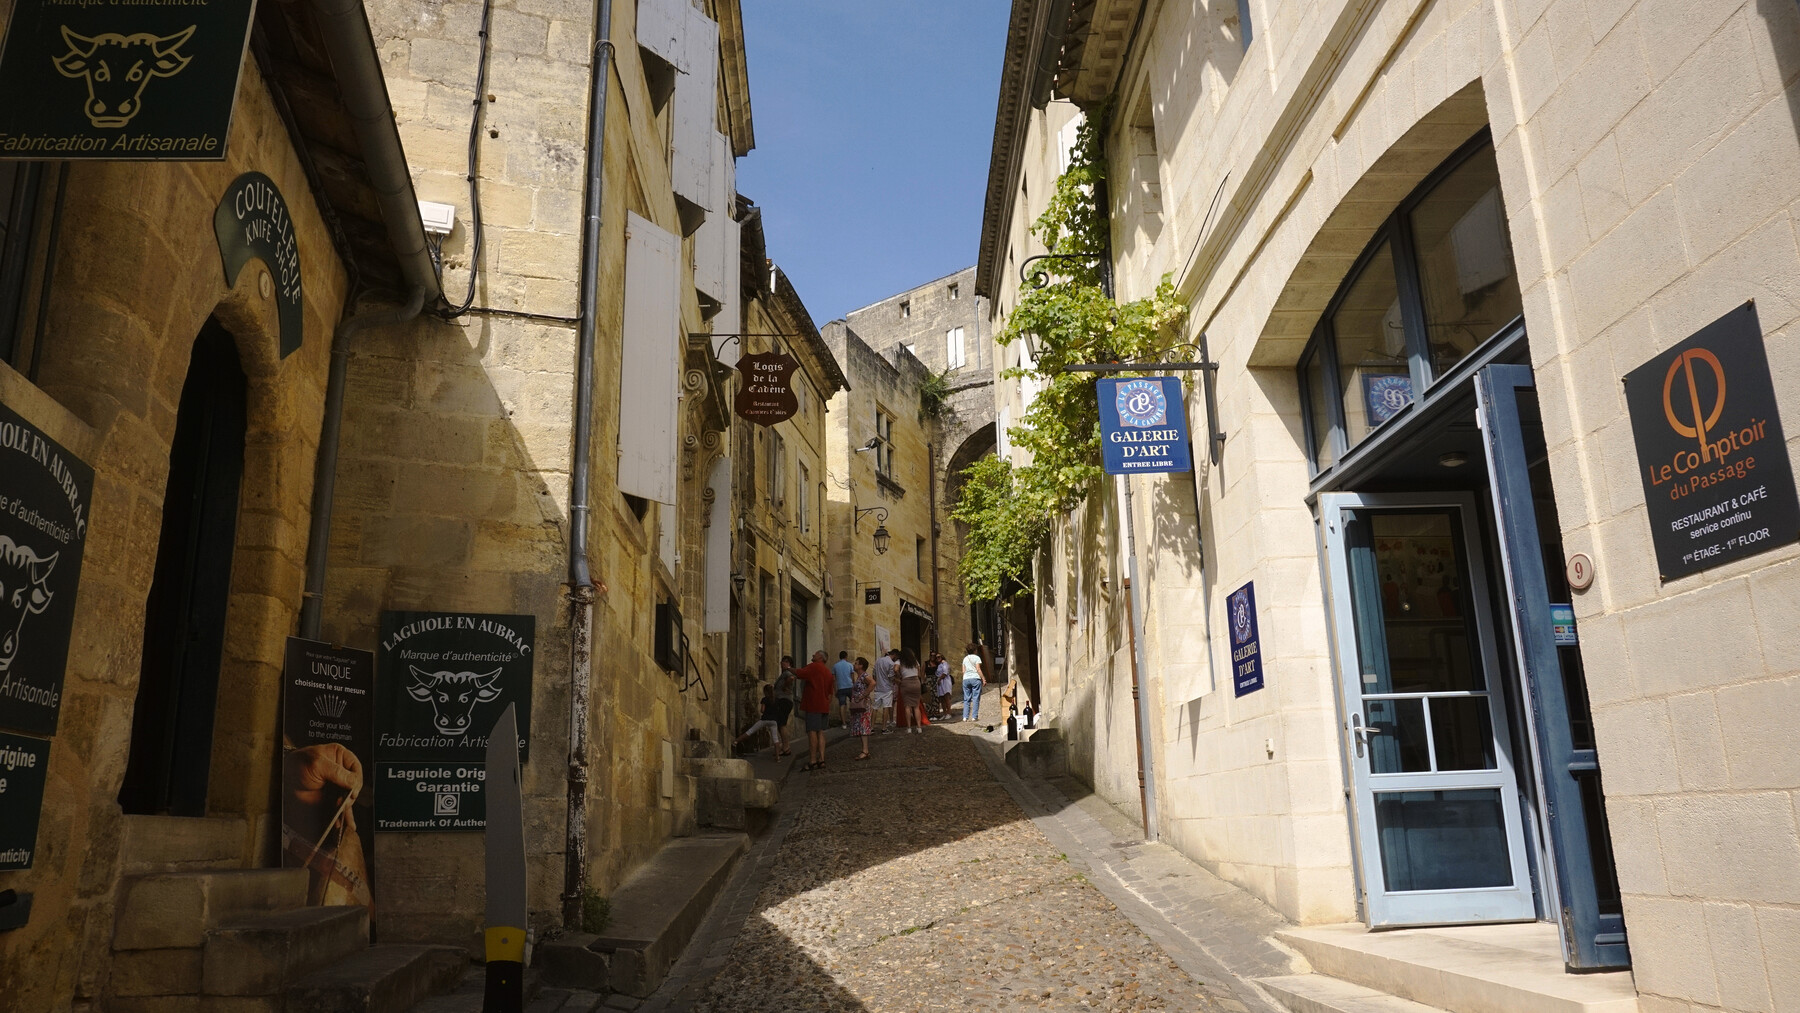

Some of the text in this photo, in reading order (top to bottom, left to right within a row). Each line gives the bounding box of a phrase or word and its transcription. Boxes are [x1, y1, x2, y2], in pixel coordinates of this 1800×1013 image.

[111, 133, 218, 151] Artisanale
[246, 219, 271, 245] KNIFE
[236, 182, 300, 304] COUTELLERIE
[275, 242, 289, 297] SHOP
[753, 362, 783, 372] Logis
[1118, 382, 1163, 400] LE PASSAGE
[1120, 410, 1130, 418] DE
[1130, 418, 1138, 426] LA
[1110, 429, 1179, 443] GALERIE
[1122, 444, 1170, 458] D'ART
[1650, 418, 1766, 486] Le Comptoir
[31, 434, 50, 467] EN
[49, 453, 86, 540] AUBRAC
[1670, 456, 1756, 500] du Passage
[1671, 485, 1768, 532] RESTAURANT & CAFÉ
[9, 498, 70, 545] d'authenticité
[1690, 510, 1752, 540] service continu
[1694, 544, 1720, 561] ÉTAGE
[1738, 528, 1771, 546] FLOOR
[1574, 562, 1584, 580] 9
[382, 616, 531, 656] LAGUIOLE EN AUBRAC
[400, 650, 512, 662] Marque d'authenticité
[1234, 641, 1258, 662] GALERIE
[312, 661, 351, 680] UNIQUE
[1238, 659, 1256, 678] D'ART
[0, 671, 59, 708] Artisanale
[294, 678, 326, 690] choisissez
[326, 682, 332, 690] le
[344, 687, 366, 695] mesure
[379, 733, 454, 748] Fabrication
[388, 768, 486, 780] Laguiole Orig
[416, 782, 480, 792] Garantie
[378, 820, 436, 828] Trademark
[439, 819, 451, 827] Of
[0, 848, 31, 866] nticity
